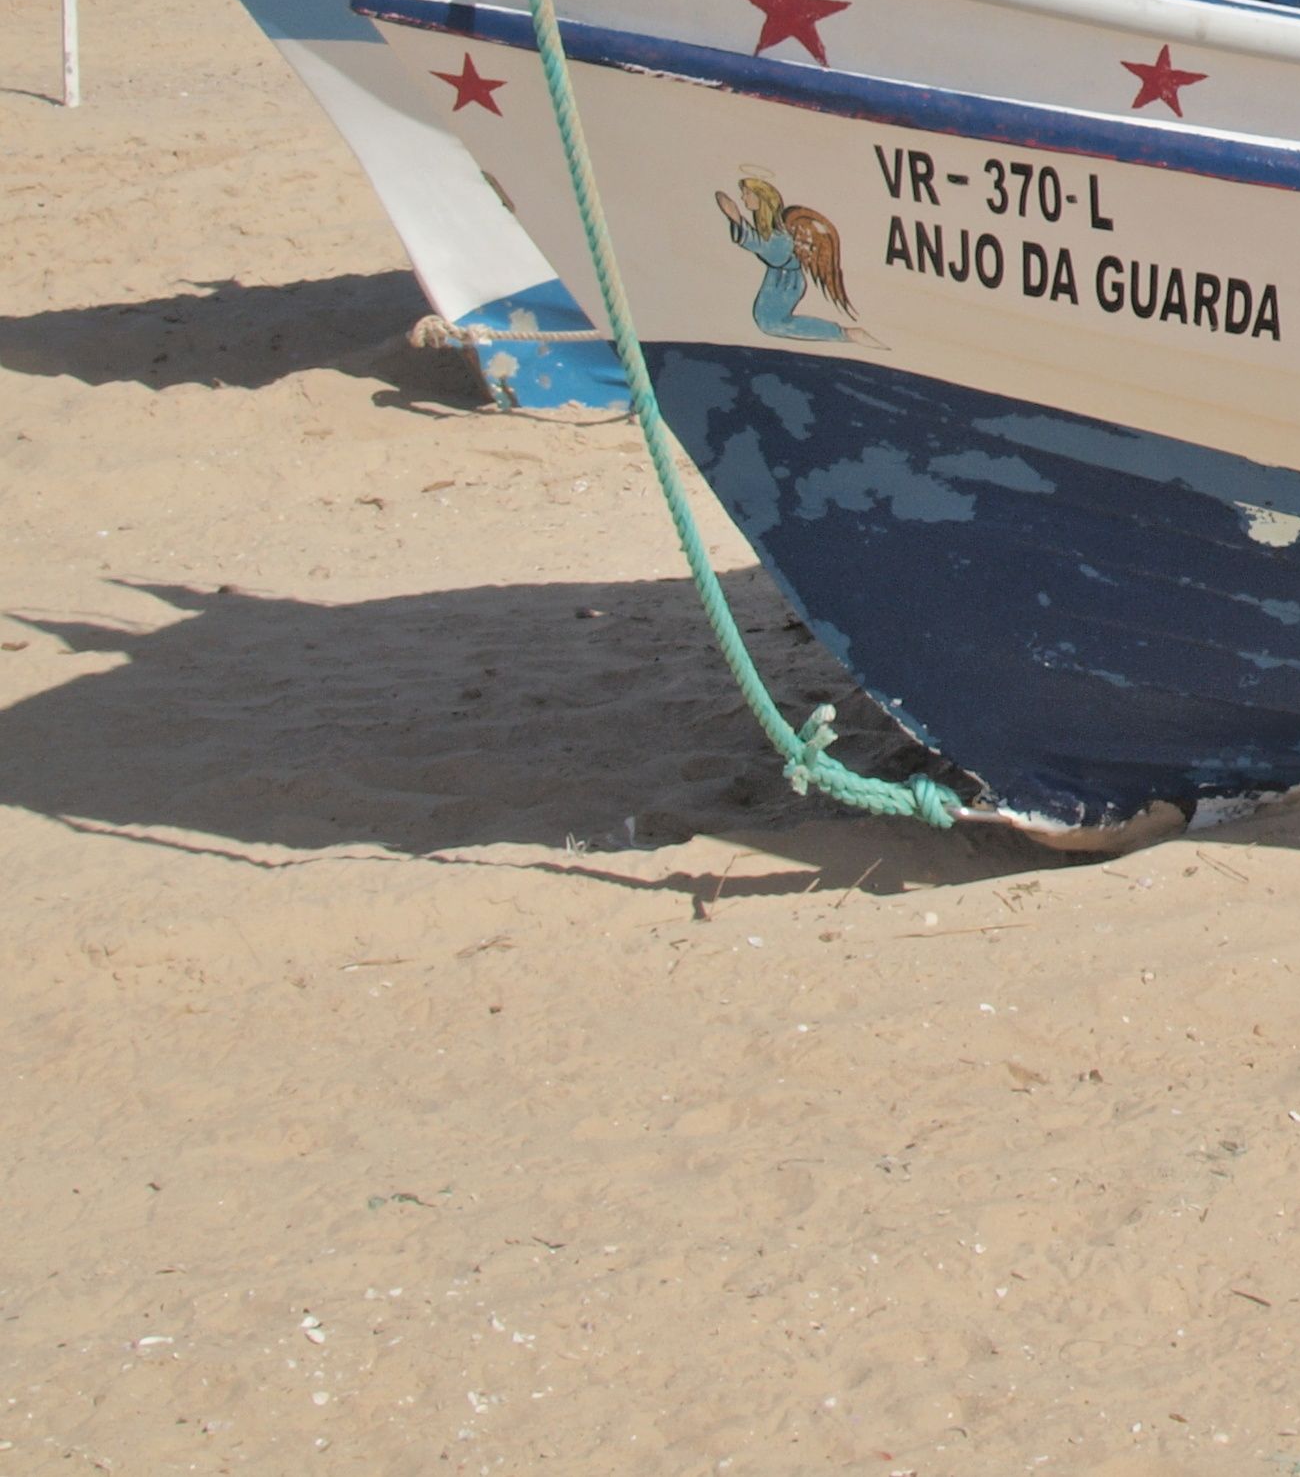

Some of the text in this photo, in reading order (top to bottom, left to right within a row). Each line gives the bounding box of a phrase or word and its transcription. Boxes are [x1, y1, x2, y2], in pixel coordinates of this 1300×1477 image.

[886, 215, 1280, 341] ANJO DA GUARDA
